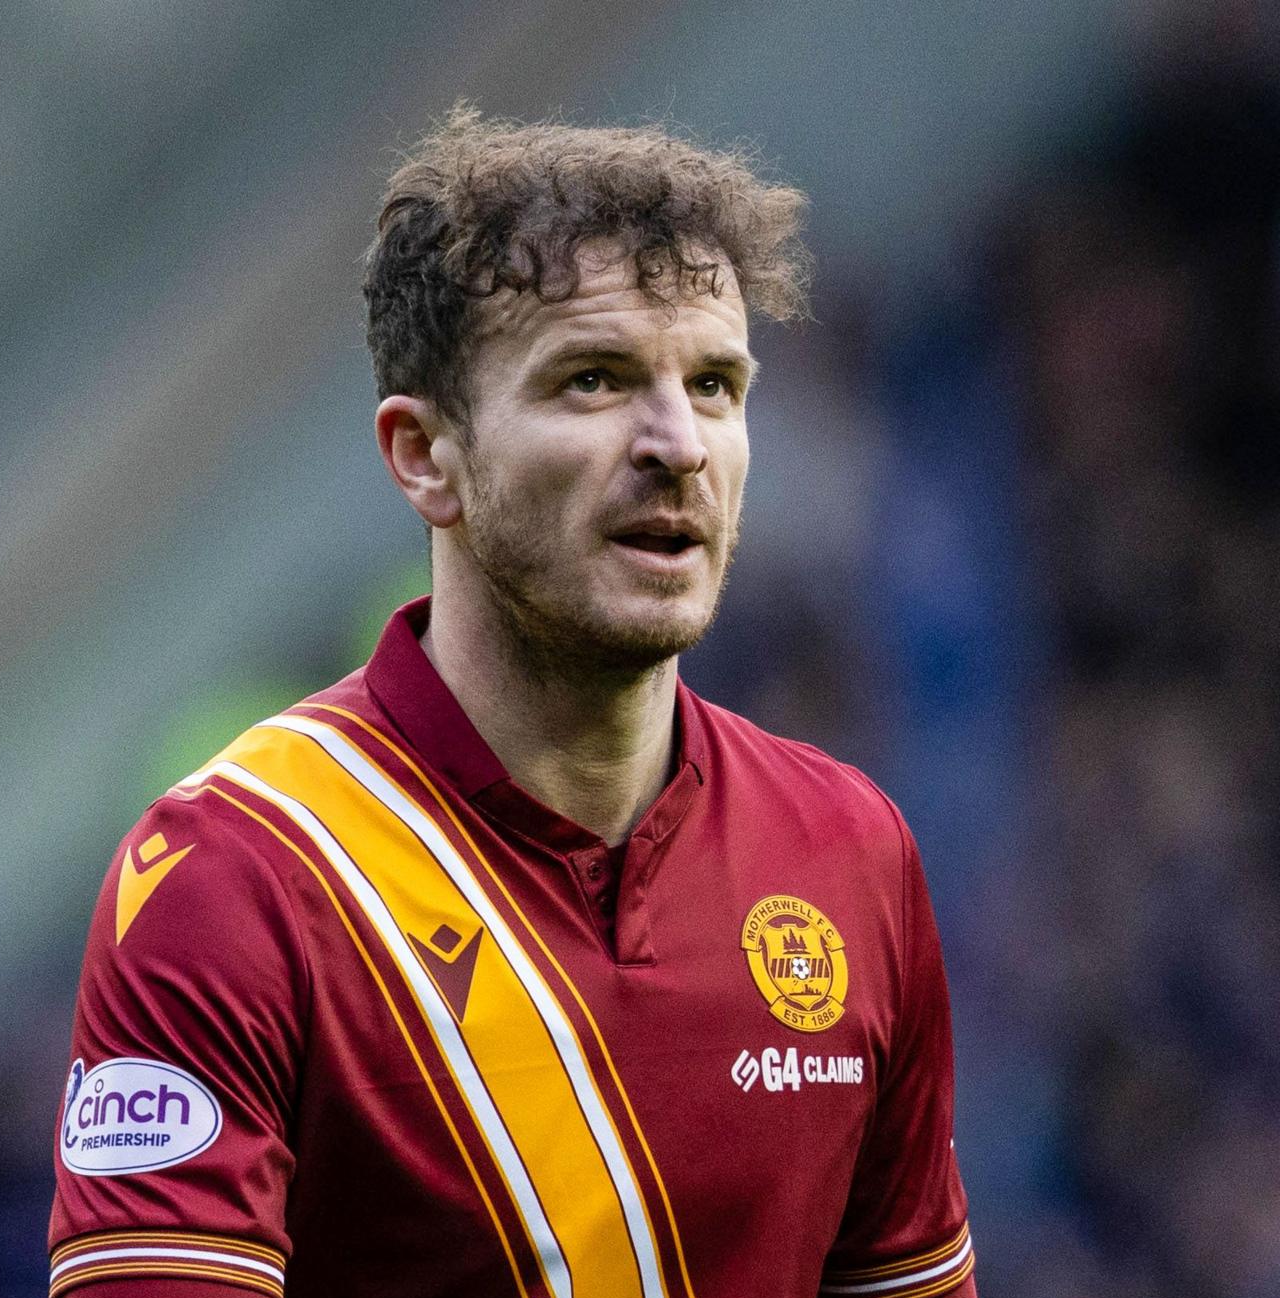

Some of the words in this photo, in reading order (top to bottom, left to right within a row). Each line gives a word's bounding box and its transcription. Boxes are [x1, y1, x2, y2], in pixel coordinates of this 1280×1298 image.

[746, 900, 813, 942] MOTHERWELL
[811, 1008, 836, 1027] 1886
[761, 1047, 801, 1091] G4
[803, 1055, 864, 1084] CLAIMS
[78, 1078, 191, 1130] cinch
[81, 1133, 171, 1151] PREMIERSHIP
